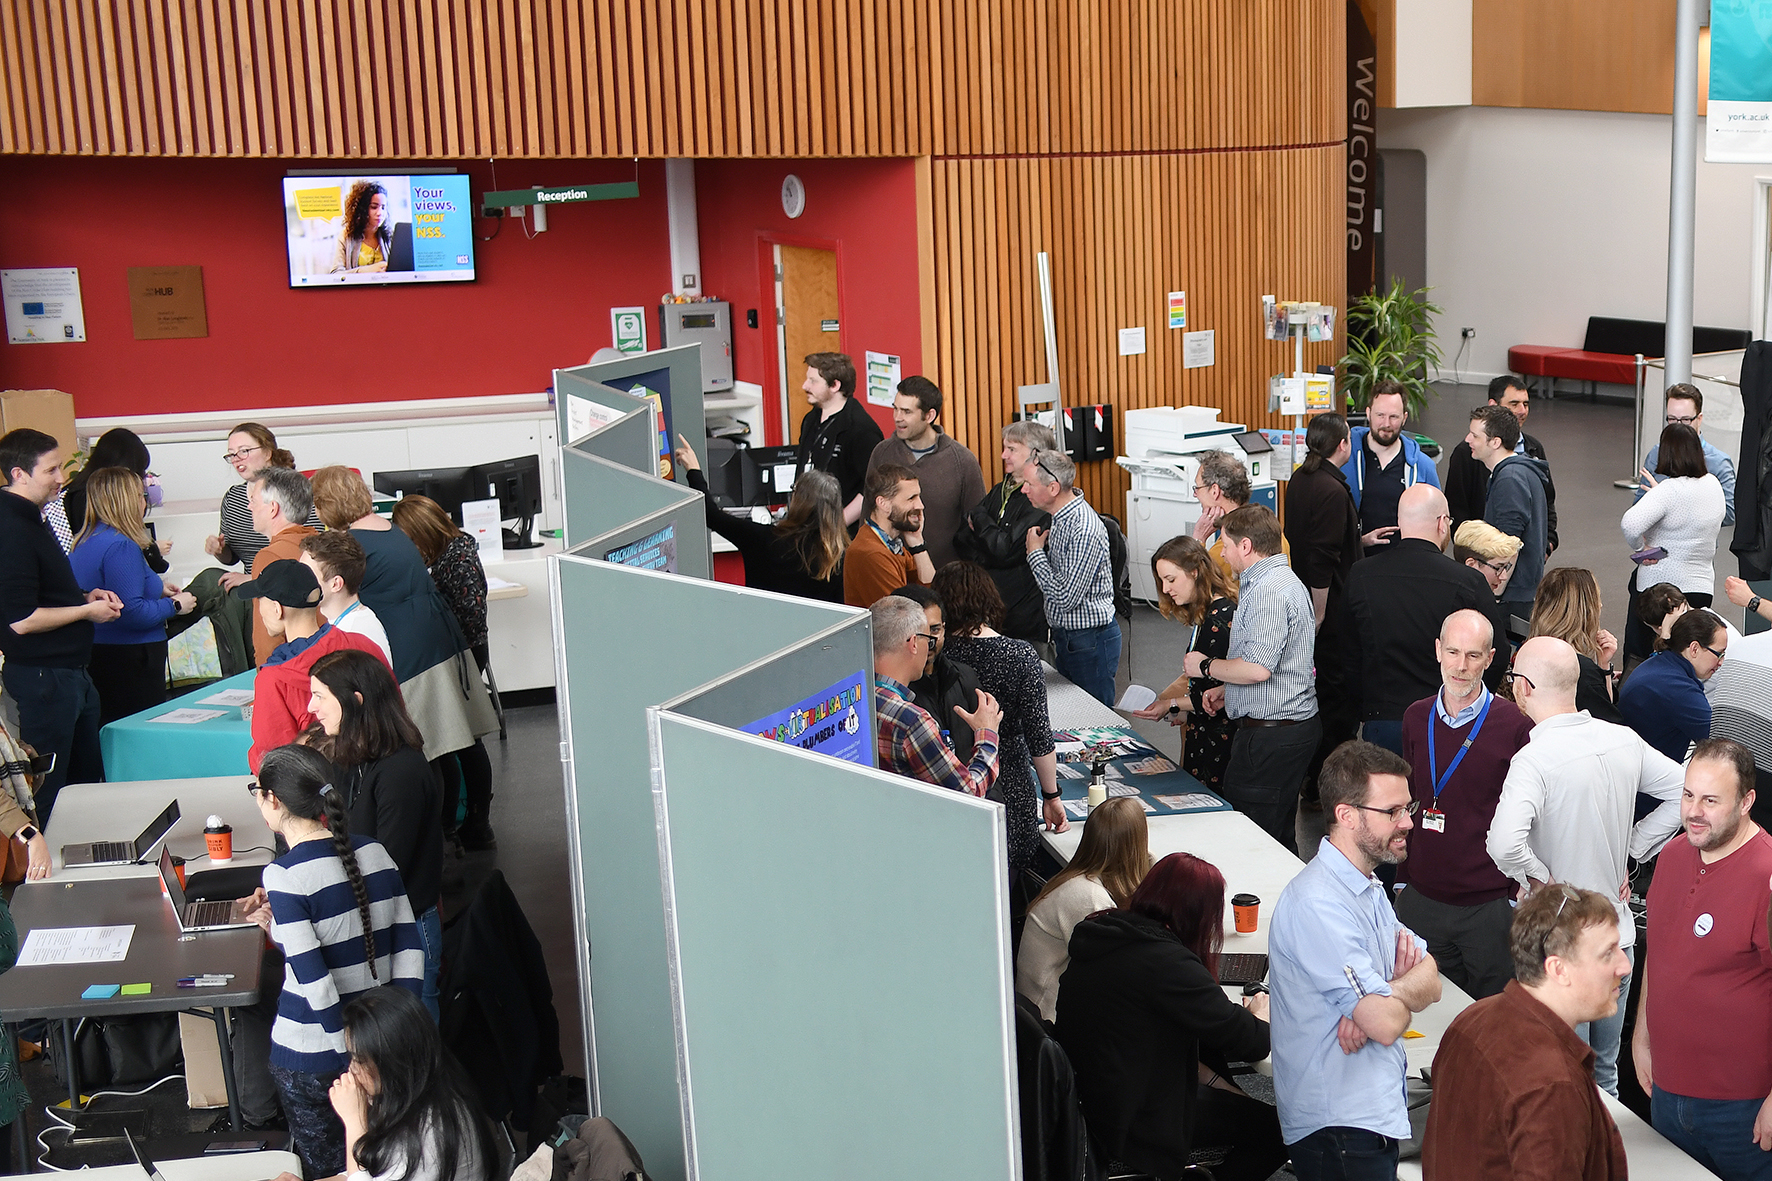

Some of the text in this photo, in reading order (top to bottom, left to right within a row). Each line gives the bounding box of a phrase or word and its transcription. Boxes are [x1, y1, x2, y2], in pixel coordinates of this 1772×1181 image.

[1728, 113, 1770, 123] york.ac.uk
[1347, 57, 1375, 251] Welcome
[414, 186, 444, 199] Your
[537, 189, 588, 203] Reception
[414, 200, 457, 212] views,
[415, 212, 446, 226] your
[416, 226, 446, 239] NSS.
[154, 287, 174, 296] HUB
[788, 683, 862, 739] VIRTUALISATION
[803, 724, 836, 750] PLUMBERS
